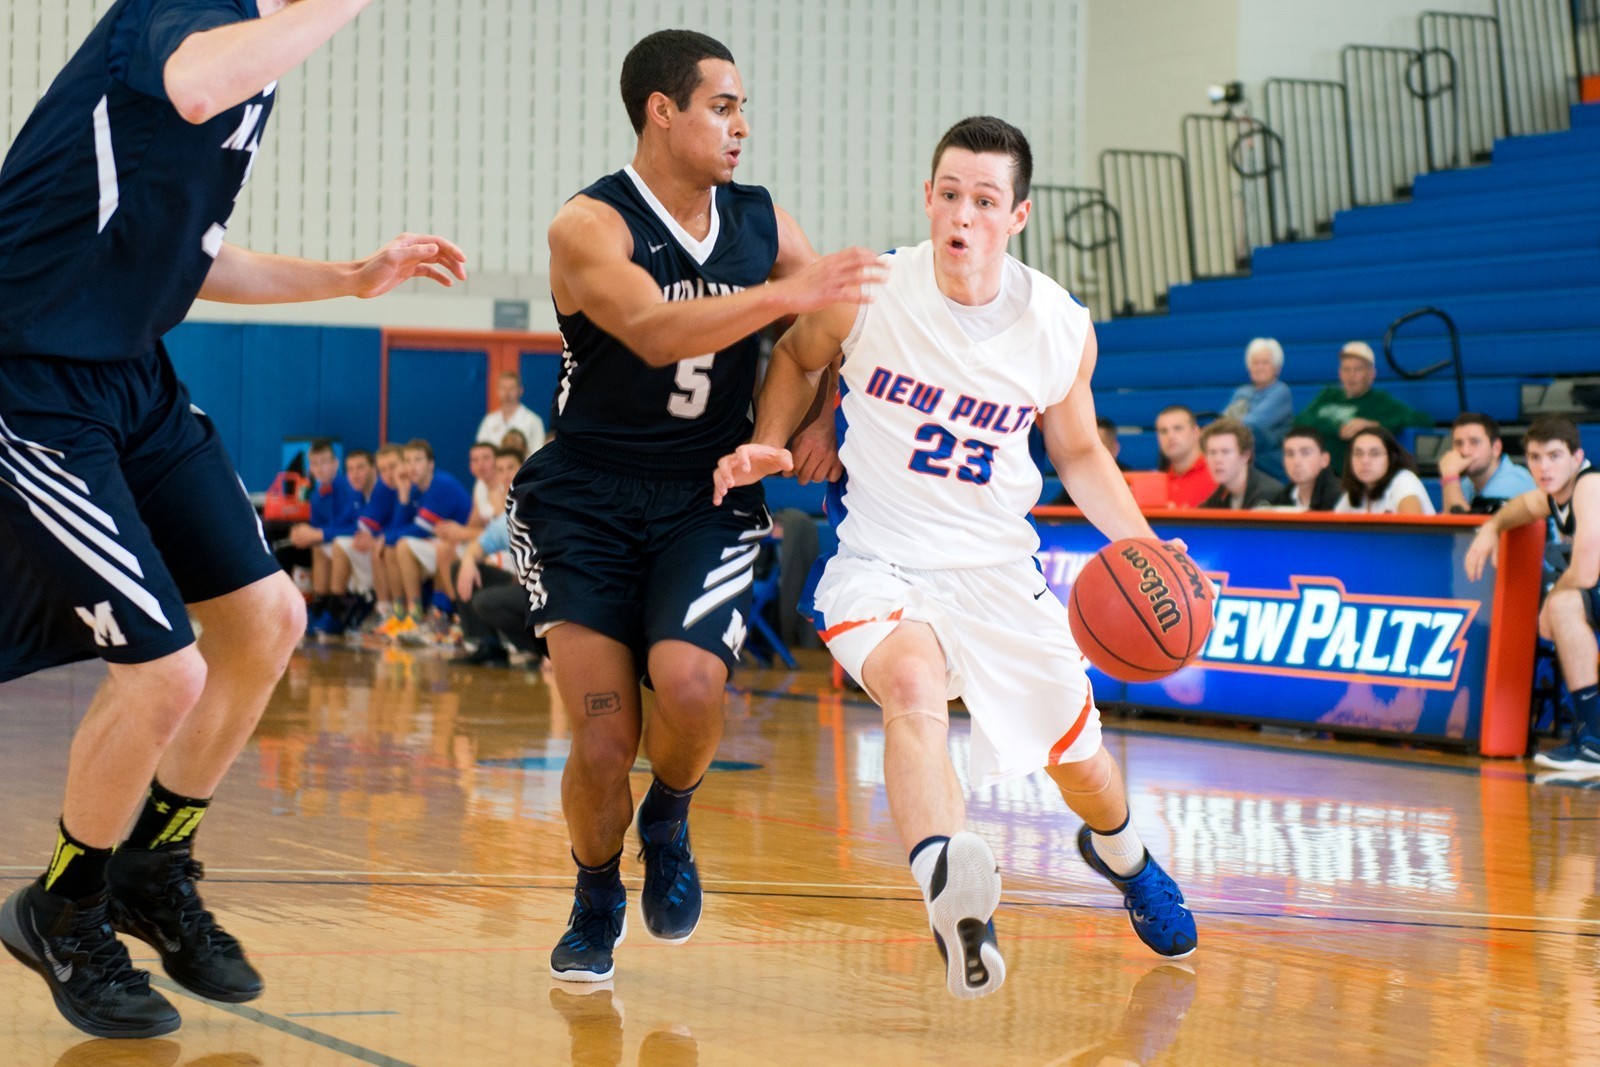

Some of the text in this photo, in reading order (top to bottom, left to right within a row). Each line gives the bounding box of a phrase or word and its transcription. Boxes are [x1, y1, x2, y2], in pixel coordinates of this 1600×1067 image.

[667, 353, 716, 420] 5
[865, 366, 1038, 434] NEW PALT
[908, 422, 999, 486] 23
[74, 600, 128, 647] M
[1121, 546, 1182, 634] Wilson
[1197, 583, 1295, 662] EW
